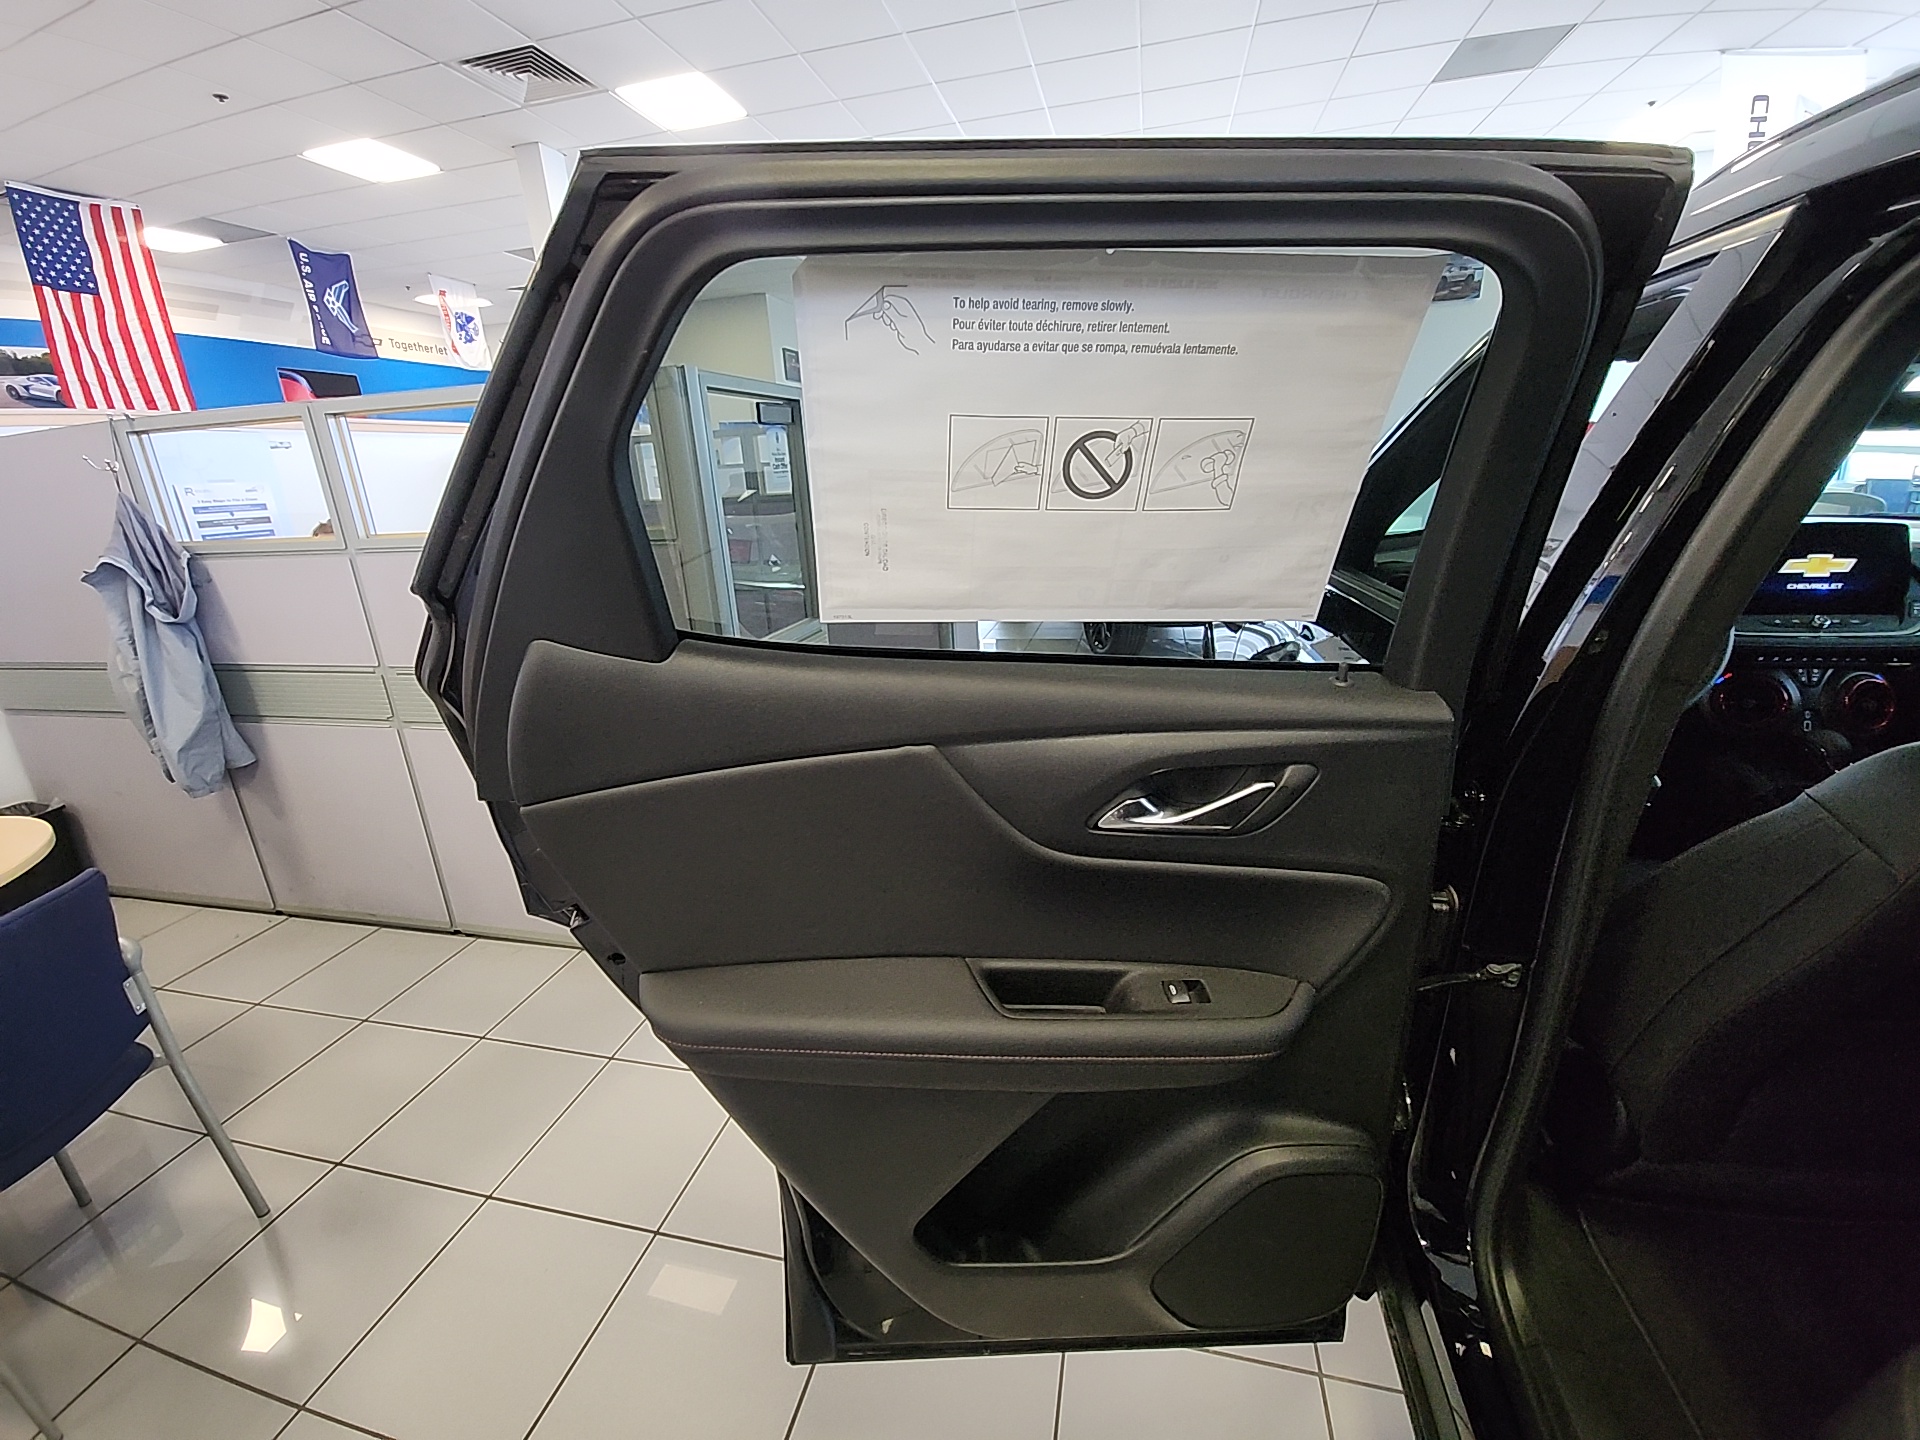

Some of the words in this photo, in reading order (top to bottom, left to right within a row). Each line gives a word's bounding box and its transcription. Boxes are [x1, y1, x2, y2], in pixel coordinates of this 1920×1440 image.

[299, 252, 312, 276] U.S.
[303, 278, 317, 302] AIR
[952, 296, 966, 309] To
[968, 296, 990, 312] help
[992, 297, 1020, 310] avoid
[1021, 298, 1059, 313] tearing,
[1061, 300, 1099, 311] remove
[1100, 299, 1135, 314] slowly.
[952, 318, 976, 330] Pour
[977, 317, 1007, 331] éviter
[1008, 320, 1033, 331] toute
[1035, 319, 1085, 334] déchirure,
[1086, 320, 1118, 333] retirer
[1118, 321, 1171, 334] lentement.
[388, 337, 434, 354] Together
[951, 338, 975, 351] Para
[976, 340, 1021, 353] ayudarse
[1023, 342, 1030, 352] a
[1031, 340, 1060, 352] evitar
[1061, 342, 1080, 355] que
[1081, 343, 1093, 353] se
[1094, 343, 1129, 355] rompa,
[1130, 341, 1181, 354] remuévala
[1182, 343, 1239, 356] lentamente.
